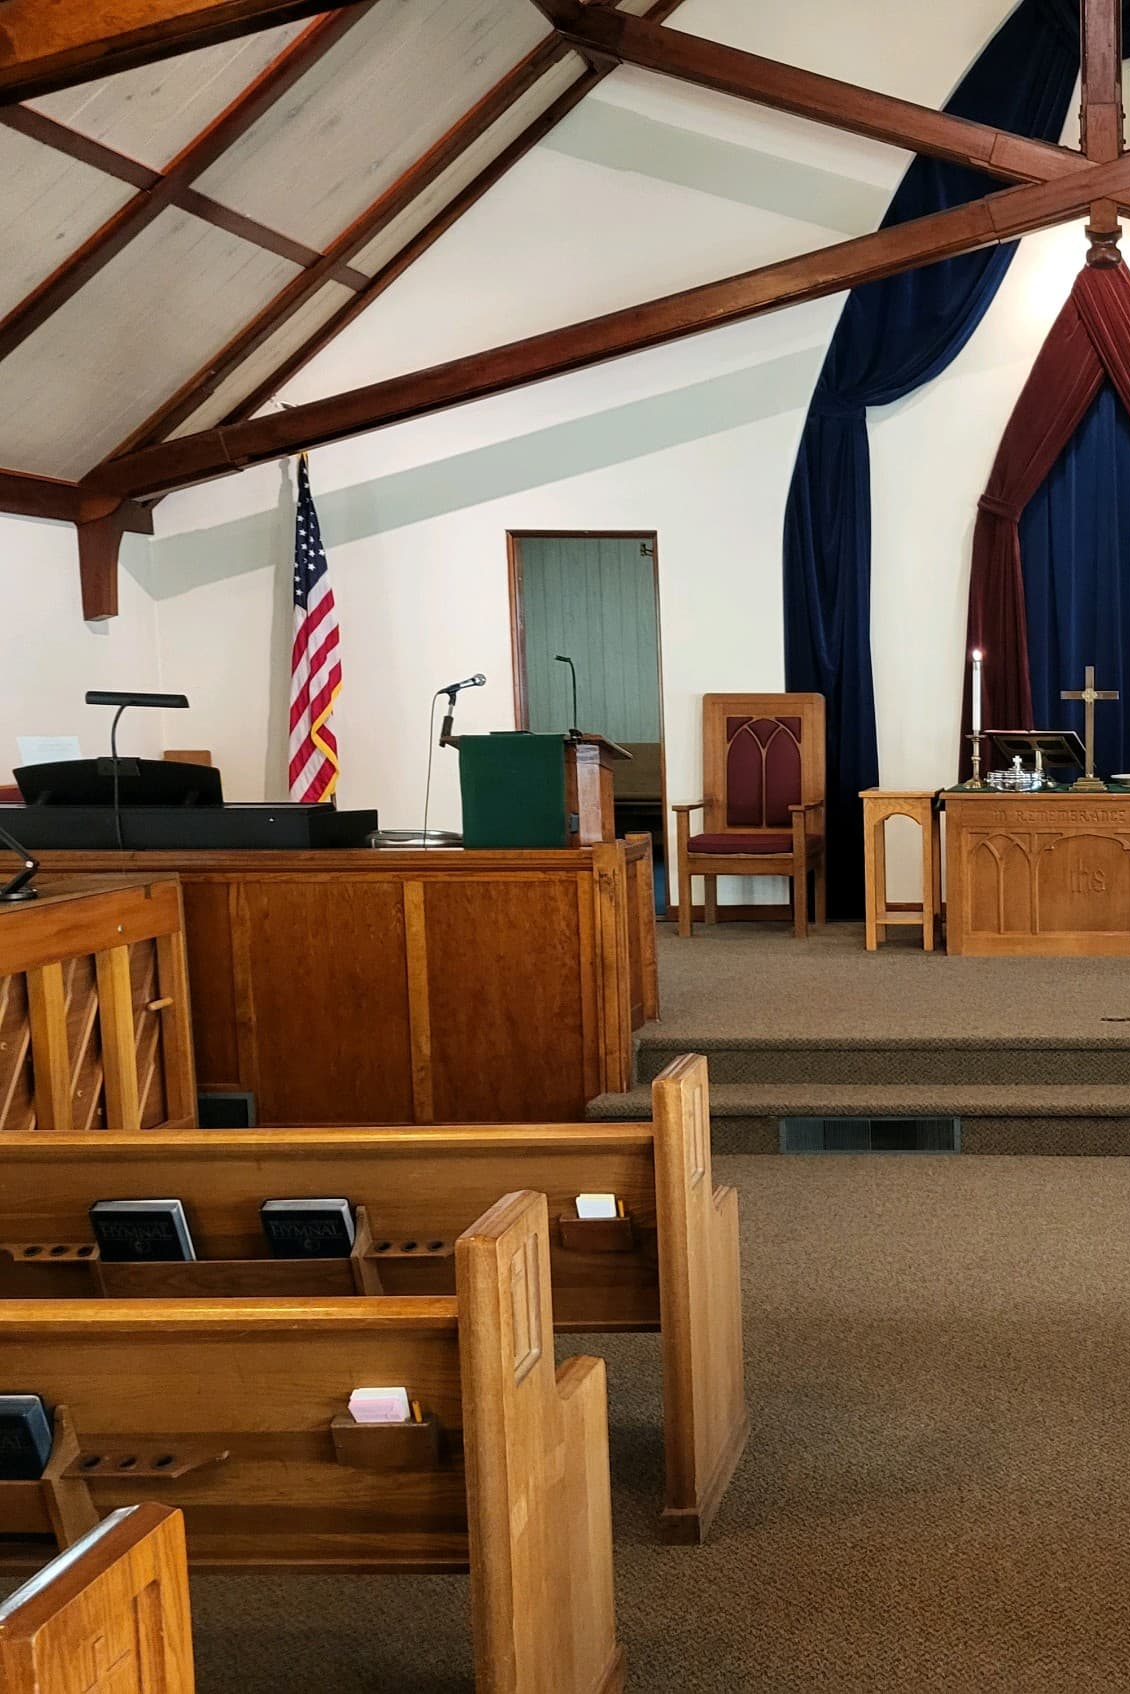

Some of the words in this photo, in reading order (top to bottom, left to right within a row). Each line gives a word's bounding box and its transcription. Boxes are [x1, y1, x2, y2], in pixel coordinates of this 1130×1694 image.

[1015, 809, 1126, 824] REMEMBRANCE
[100, 1223, 174, 1239] HYMNAL
[270, 1222, 344, 1238] HYMNAL
